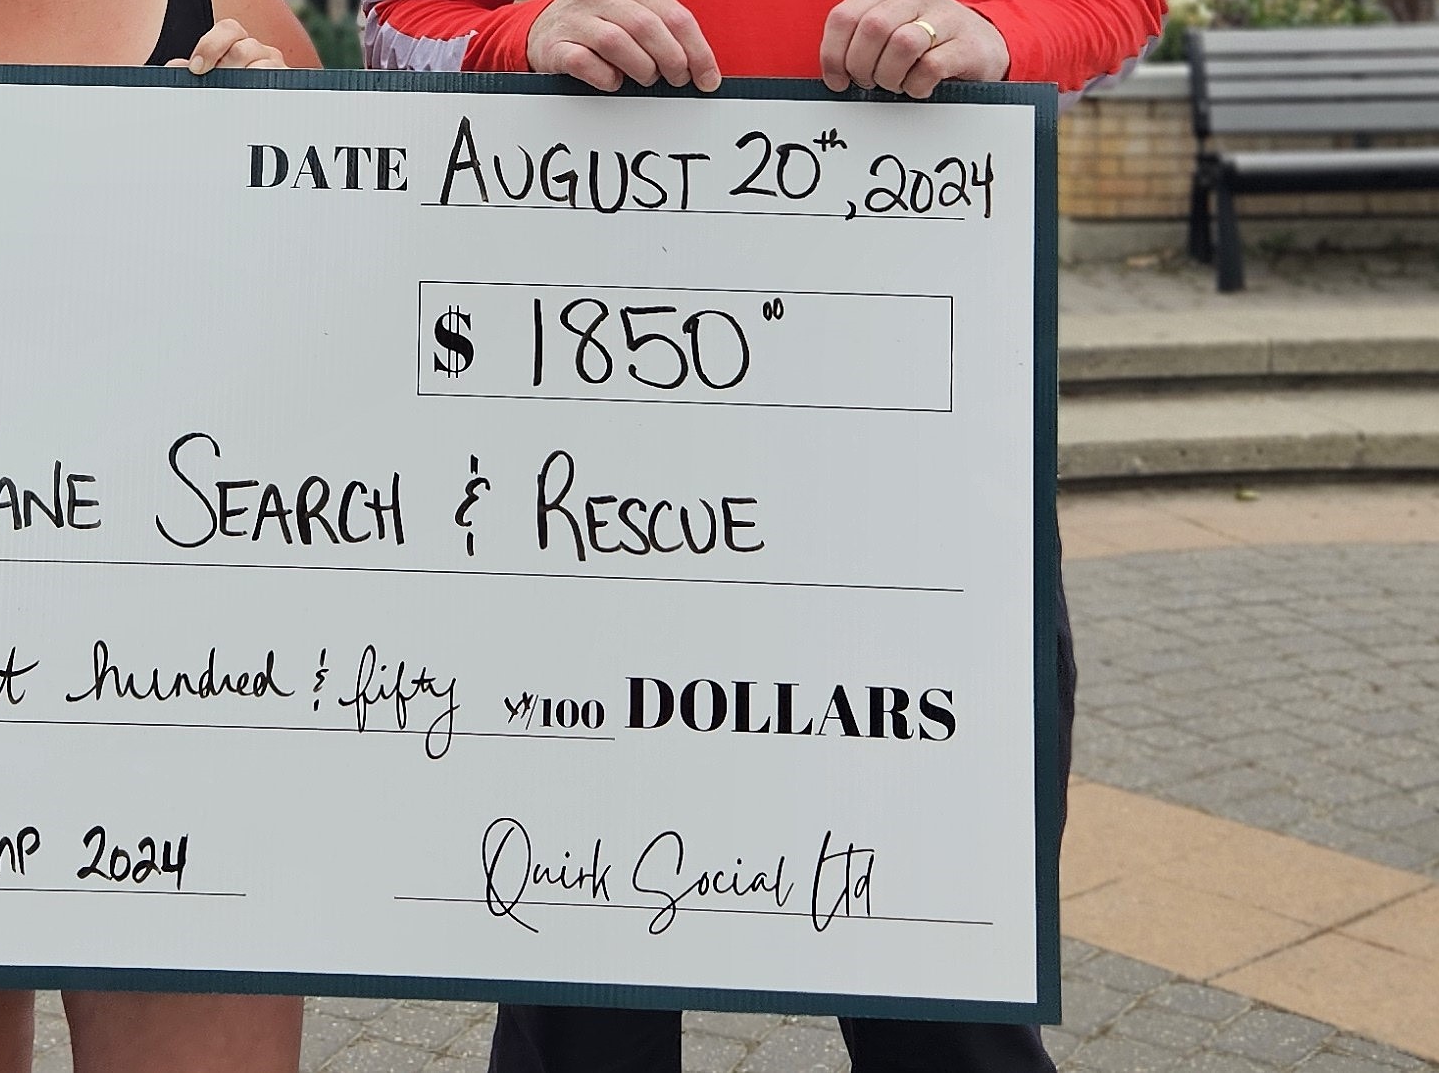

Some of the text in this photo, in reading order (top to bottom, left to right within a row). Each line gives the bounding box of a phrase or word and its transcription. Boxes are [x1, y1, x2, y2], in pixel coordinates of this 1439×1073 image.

[246, 144, 408, 192] DATE
[441, 116, 709, 214] AUGUST
[434, 305, 475, 378] $
[156, 432, 405, 549] SEARCH
[537, 449, 765, 562] RESCUE
[66, 640, 295, 702] hundred
[338, 643, 461, 759] fifty
[625, 676, 956, 742] DOLLARS
[76, 826, 189, 891] 2024
[482, 818, 876, 935] Quirk Social Ltd
